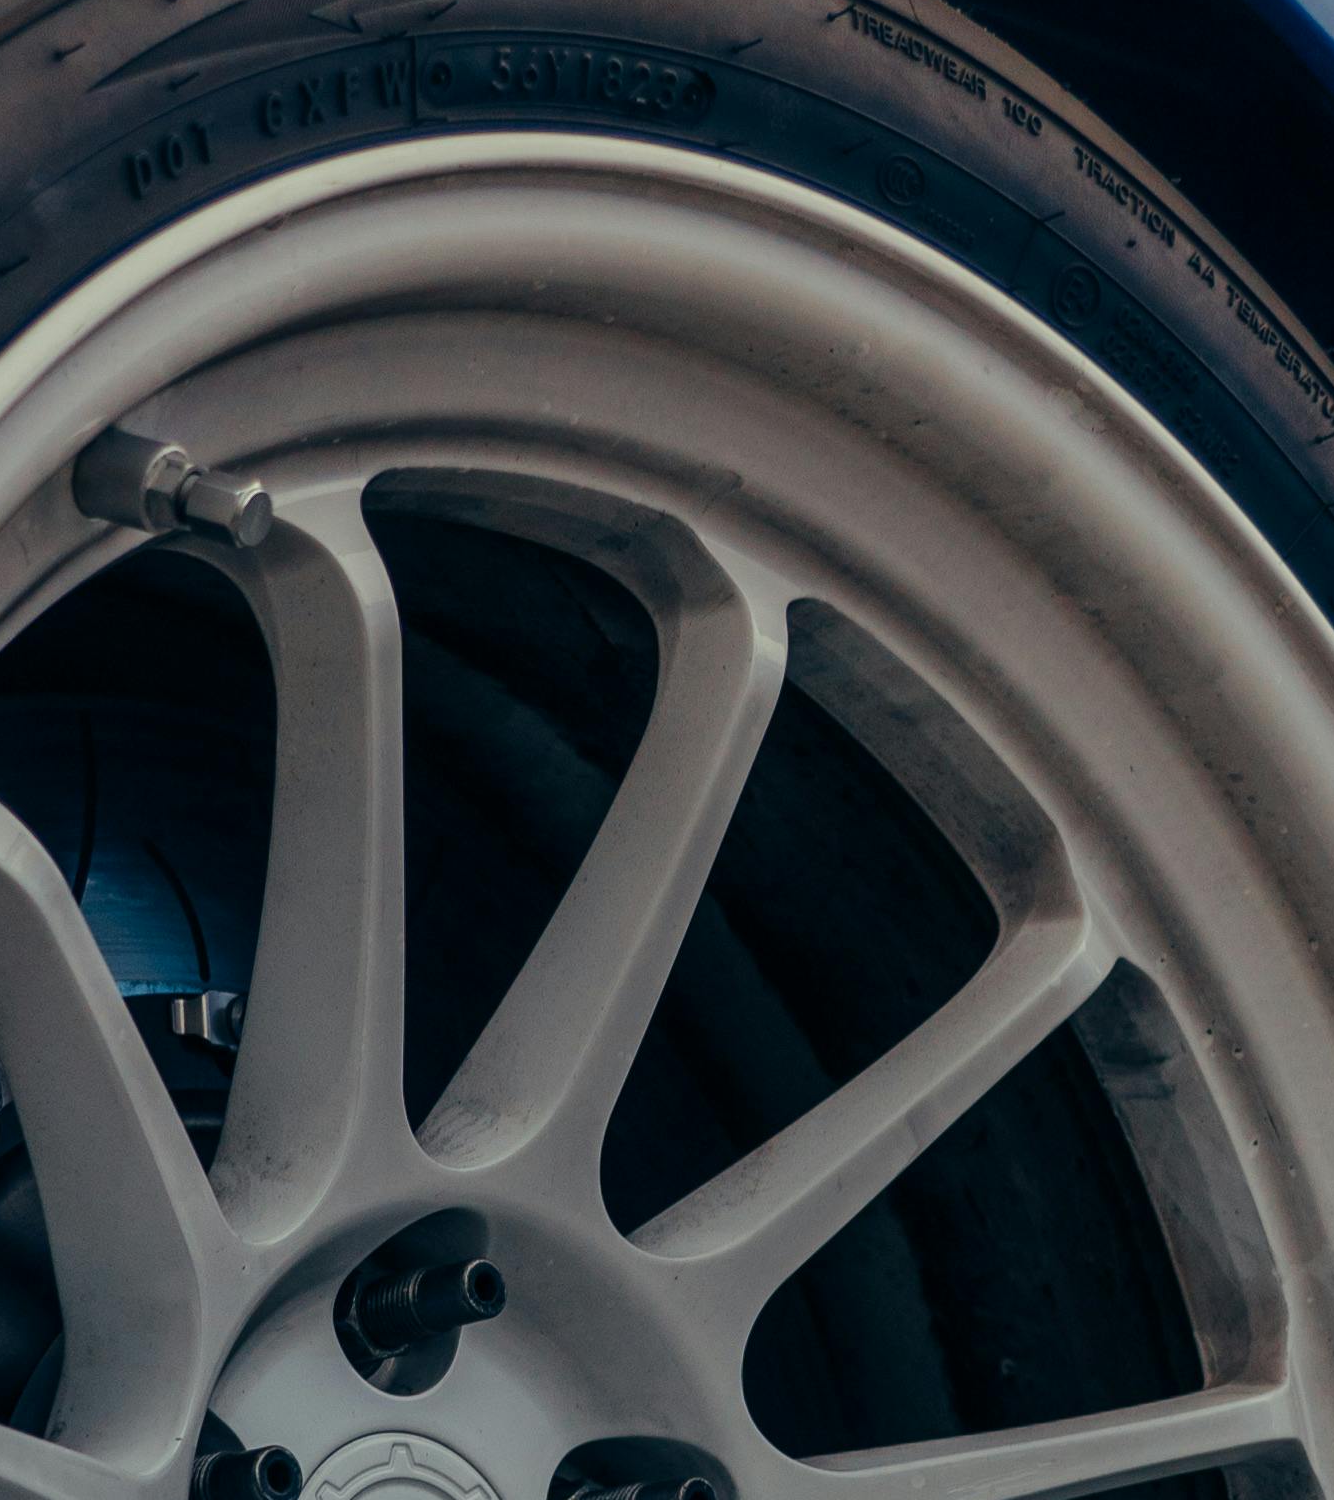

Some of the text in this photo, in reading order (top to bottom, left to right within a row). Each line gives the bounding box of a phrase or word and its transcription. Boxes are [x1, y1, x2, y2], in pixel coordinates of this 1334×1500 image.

[121, 118, 219, 202] DOT
[849, 7, 988, 96] TREADWEAR
[1000, 94, 1043, 139] 100
[1072, 146, 1179, 248] TRACTION
[1187, 249, 1219, 289] AA
